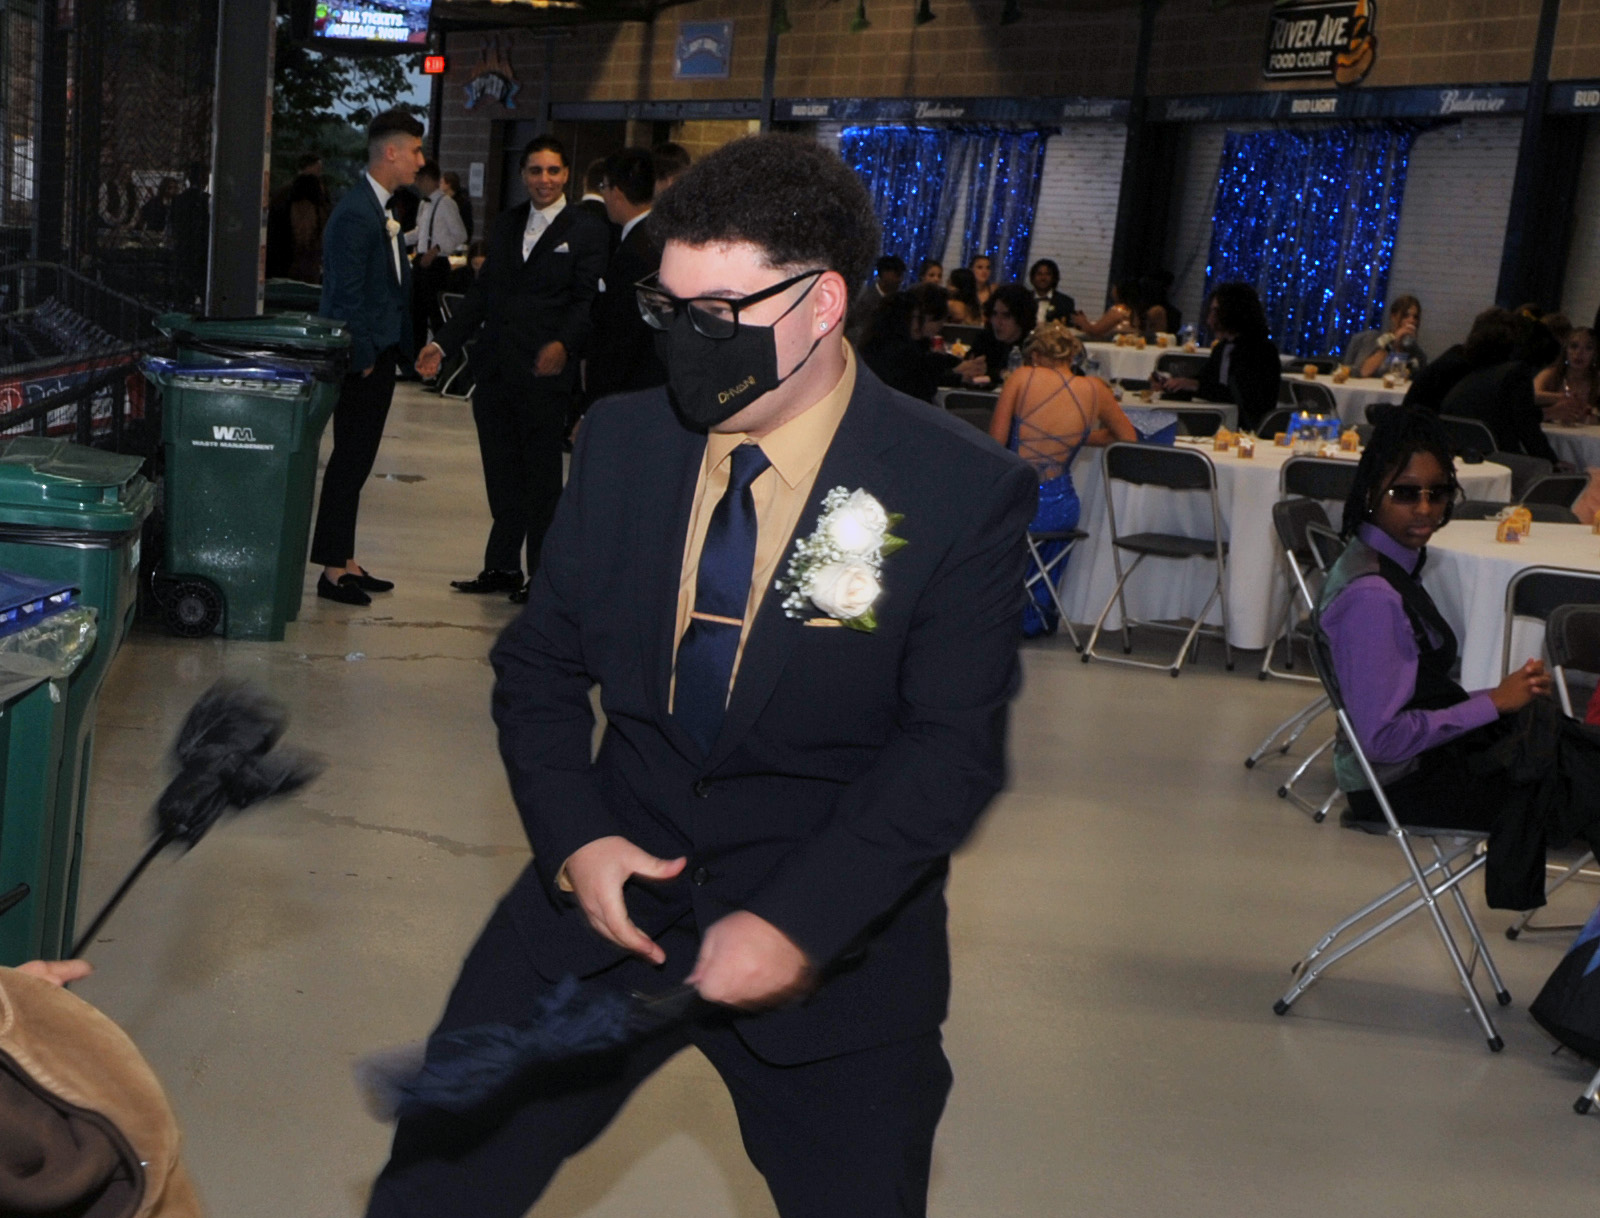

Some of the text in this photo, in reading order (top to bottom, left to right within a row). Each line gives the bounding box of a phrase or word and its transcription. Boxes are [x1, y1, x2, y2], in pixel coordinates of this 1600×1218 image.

[341, 10, 403, 26] ALL TICKETS
[350, 24, 376, 37] SALE
[1270, 18, 1317, 49] RIVER
[1269, 51, 1332, 69] FOOD COURT
[192, 440, 274, 451] WASTE MANAGEMENT
